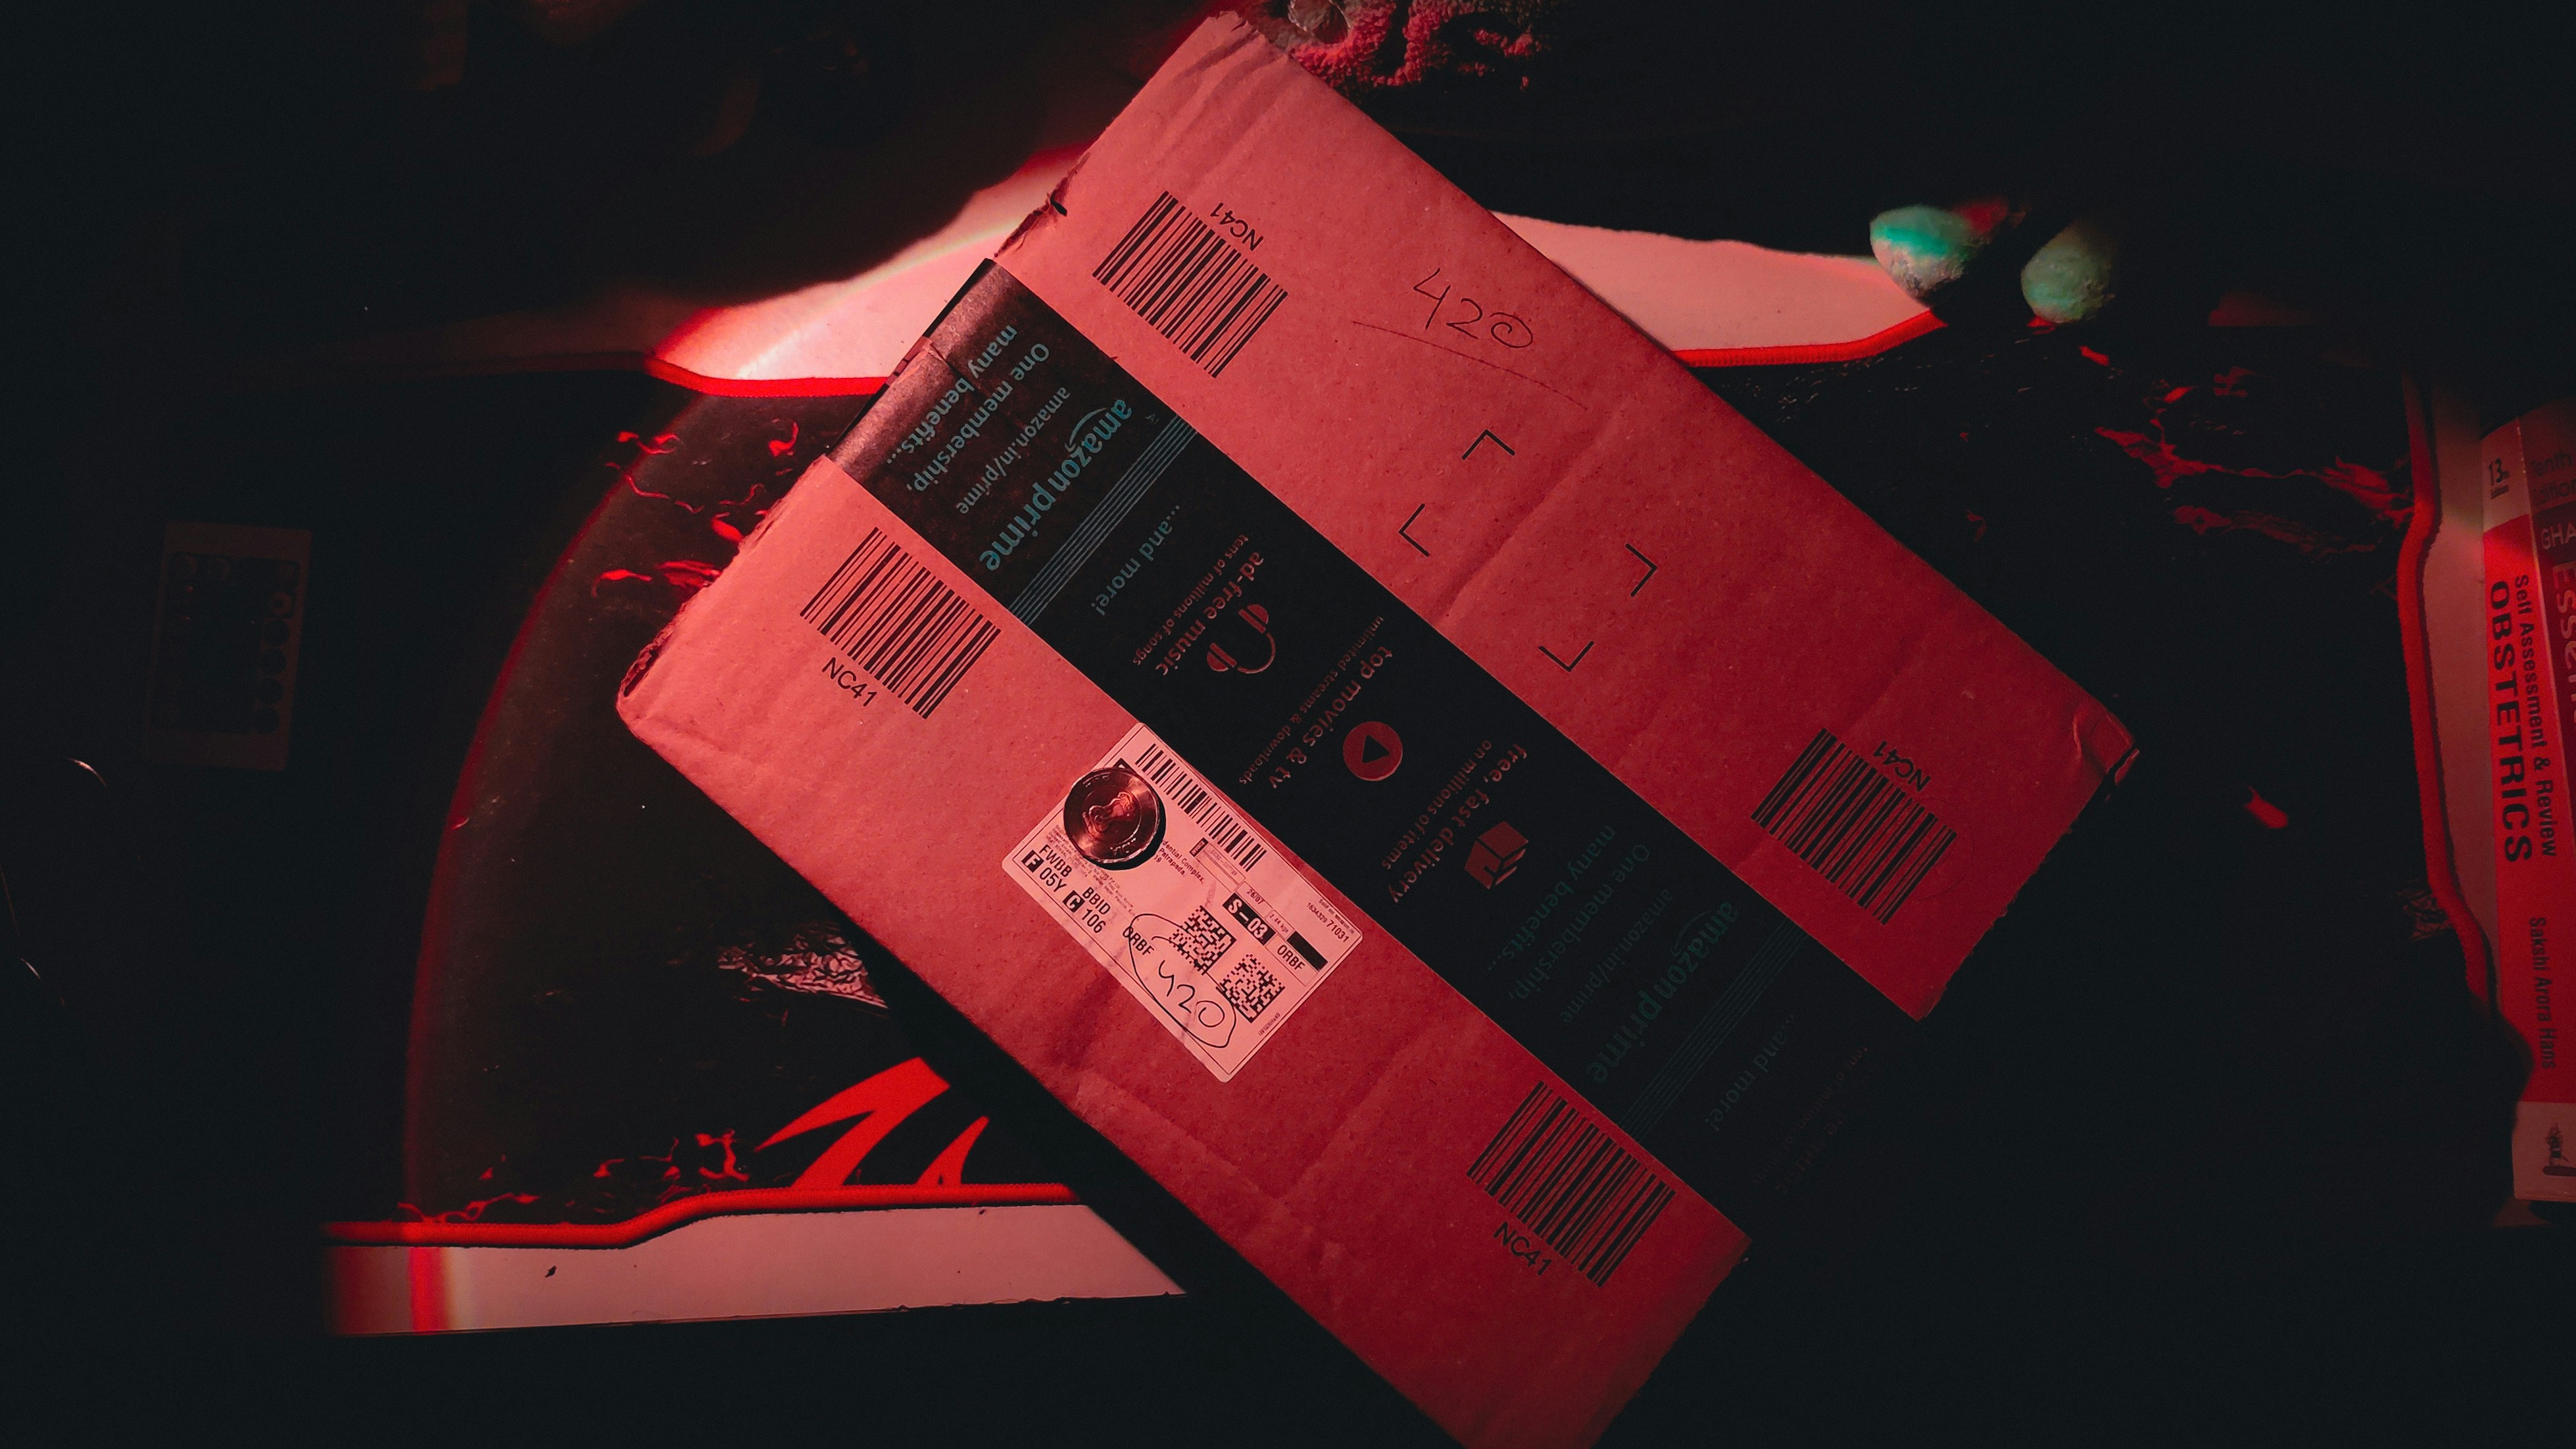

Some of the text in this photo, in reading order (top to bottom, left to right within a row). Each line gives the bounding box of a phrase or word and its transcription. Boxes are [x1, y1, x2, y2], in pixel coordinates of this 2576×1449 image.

[1210, 202, 1264, 251] NC41
[1413, 268, 1534, 348] 420
[886, 324, 1018, 465] many benefits...
[906, 343, 1050, 492] One membership,
[955, 386, 1071, 515] amazon.in/prime
[978, 398, 1133, 572] amazon prime
[1090, 557, 1142, 617] more!
[1132, 534, 1250, 667] tens of millions of songs
[1154, 551, 1265, 677] ad-free music
[821, 657, 878, 707] NC41
[1238, 615, 1385, 786] unlimited streams & downloads
[1270, 646, 1394, 790] top movies & tv
[2490, 581, 2533, 863] OBSTETRICS
[2514, 574, 2559, 857] Self Assessment & Review
[1381, 740, 1493, 870] on millions of items
[1388, 744, 1528, 904] free, fast delivery
[1872, 740, 1932, 792] NC41
[1038, 844, 1073, 878] FWBB
[1039, 867, 1067, 893] 05Y
[1082, 886, 1111, 915] BBID
[1161, 840, 1182, 860] dential
[1566, 824, 1617, 882] many
[1081, 909, 1106, 934] 106
[1326, 919, 1349, 943] 71031
[1507, 843, 1651, 1001] One membership,
[1559, 888, 1674, 1024] amazon.in/prime
[1585, 901, 1739, 1084] amazon prime
[2530, 916, 2558, 1069] Sakshi Arora Hans
[1703, 1069, 1757, 1133] more!
[1493, 1222, 1552, 1277] NC41
